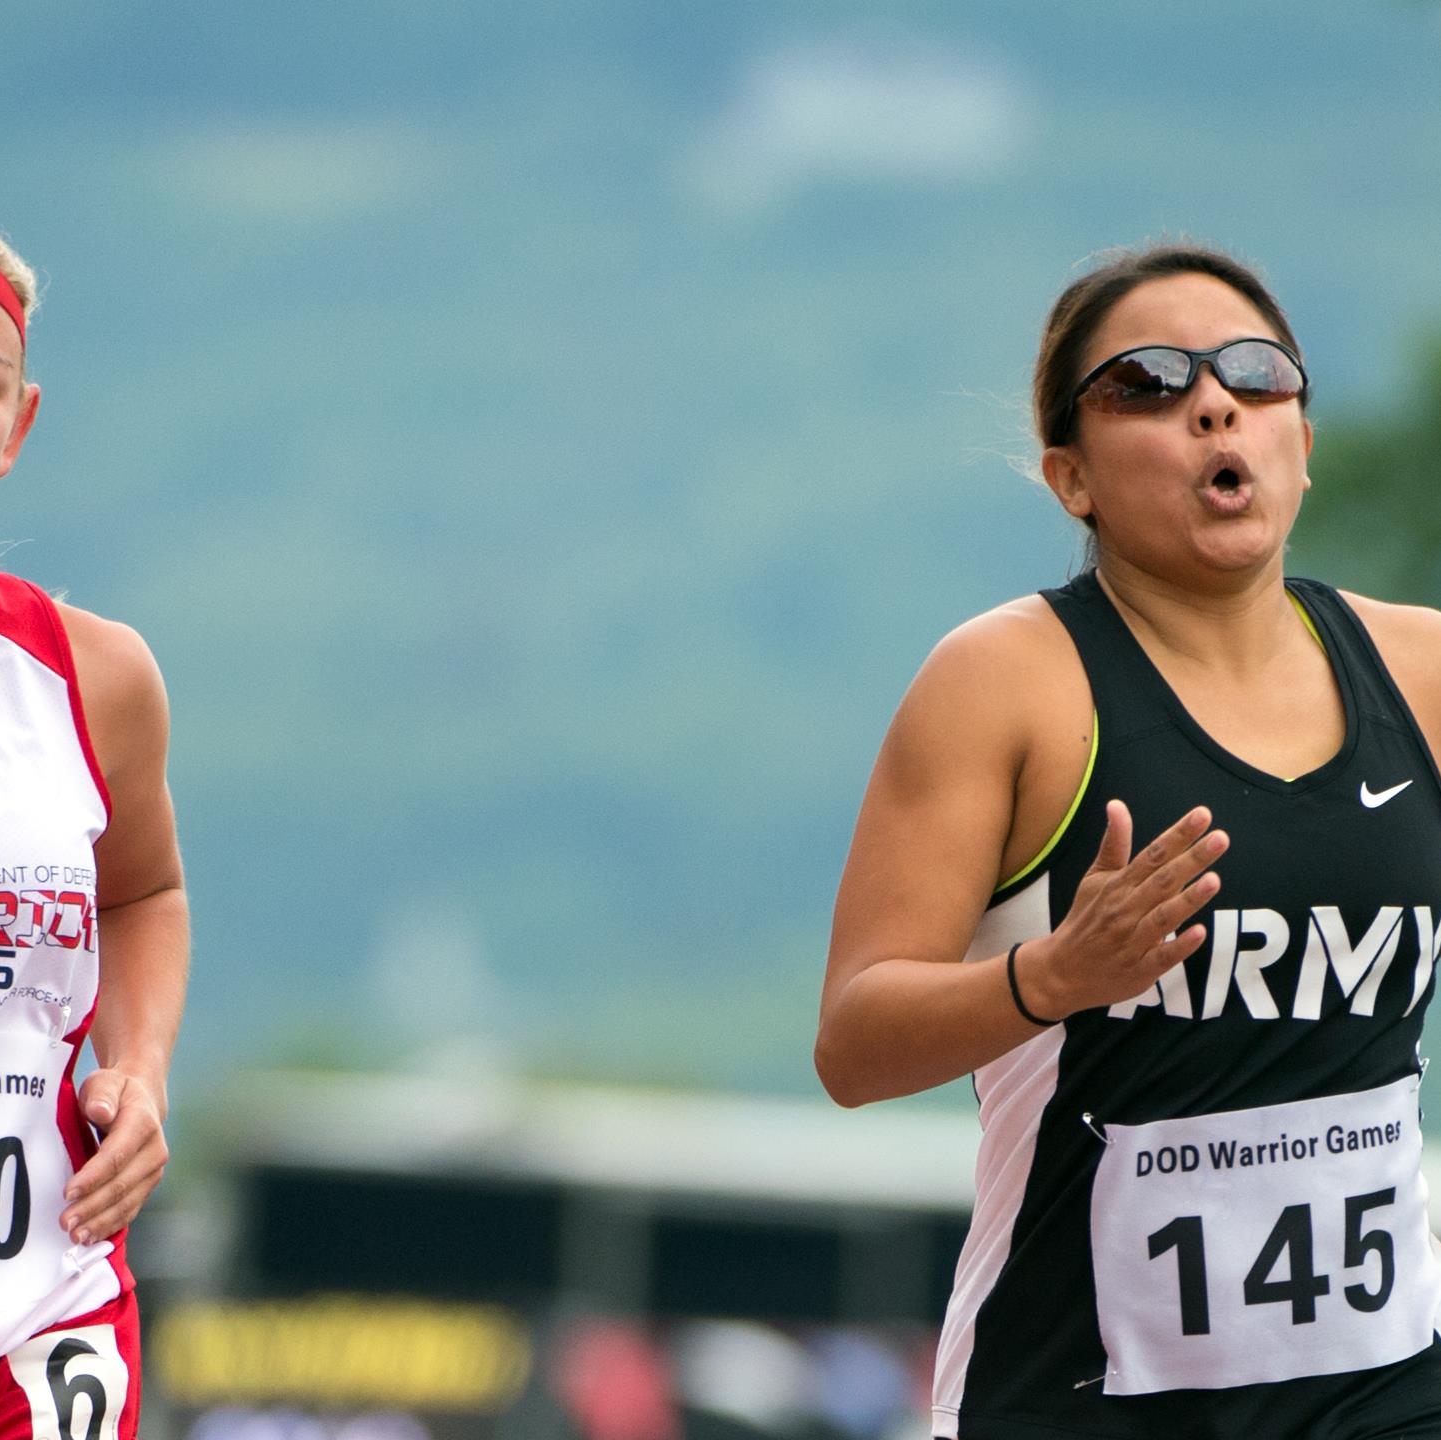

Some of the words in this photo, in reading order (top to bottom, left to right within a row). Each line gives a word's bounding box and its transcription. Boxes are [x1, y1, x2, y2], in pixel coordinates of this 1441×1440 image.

[34, 865, 59, 883] OF
[63, 866, 95, 887] DEFE
[1136, 1144, 1200, 1177] DOD
[1208, 1133, 1319, 1170] Warrior
[1326, 1120, 1402, 1154] Games
[1147, 1186, 1397, 1336] 145
